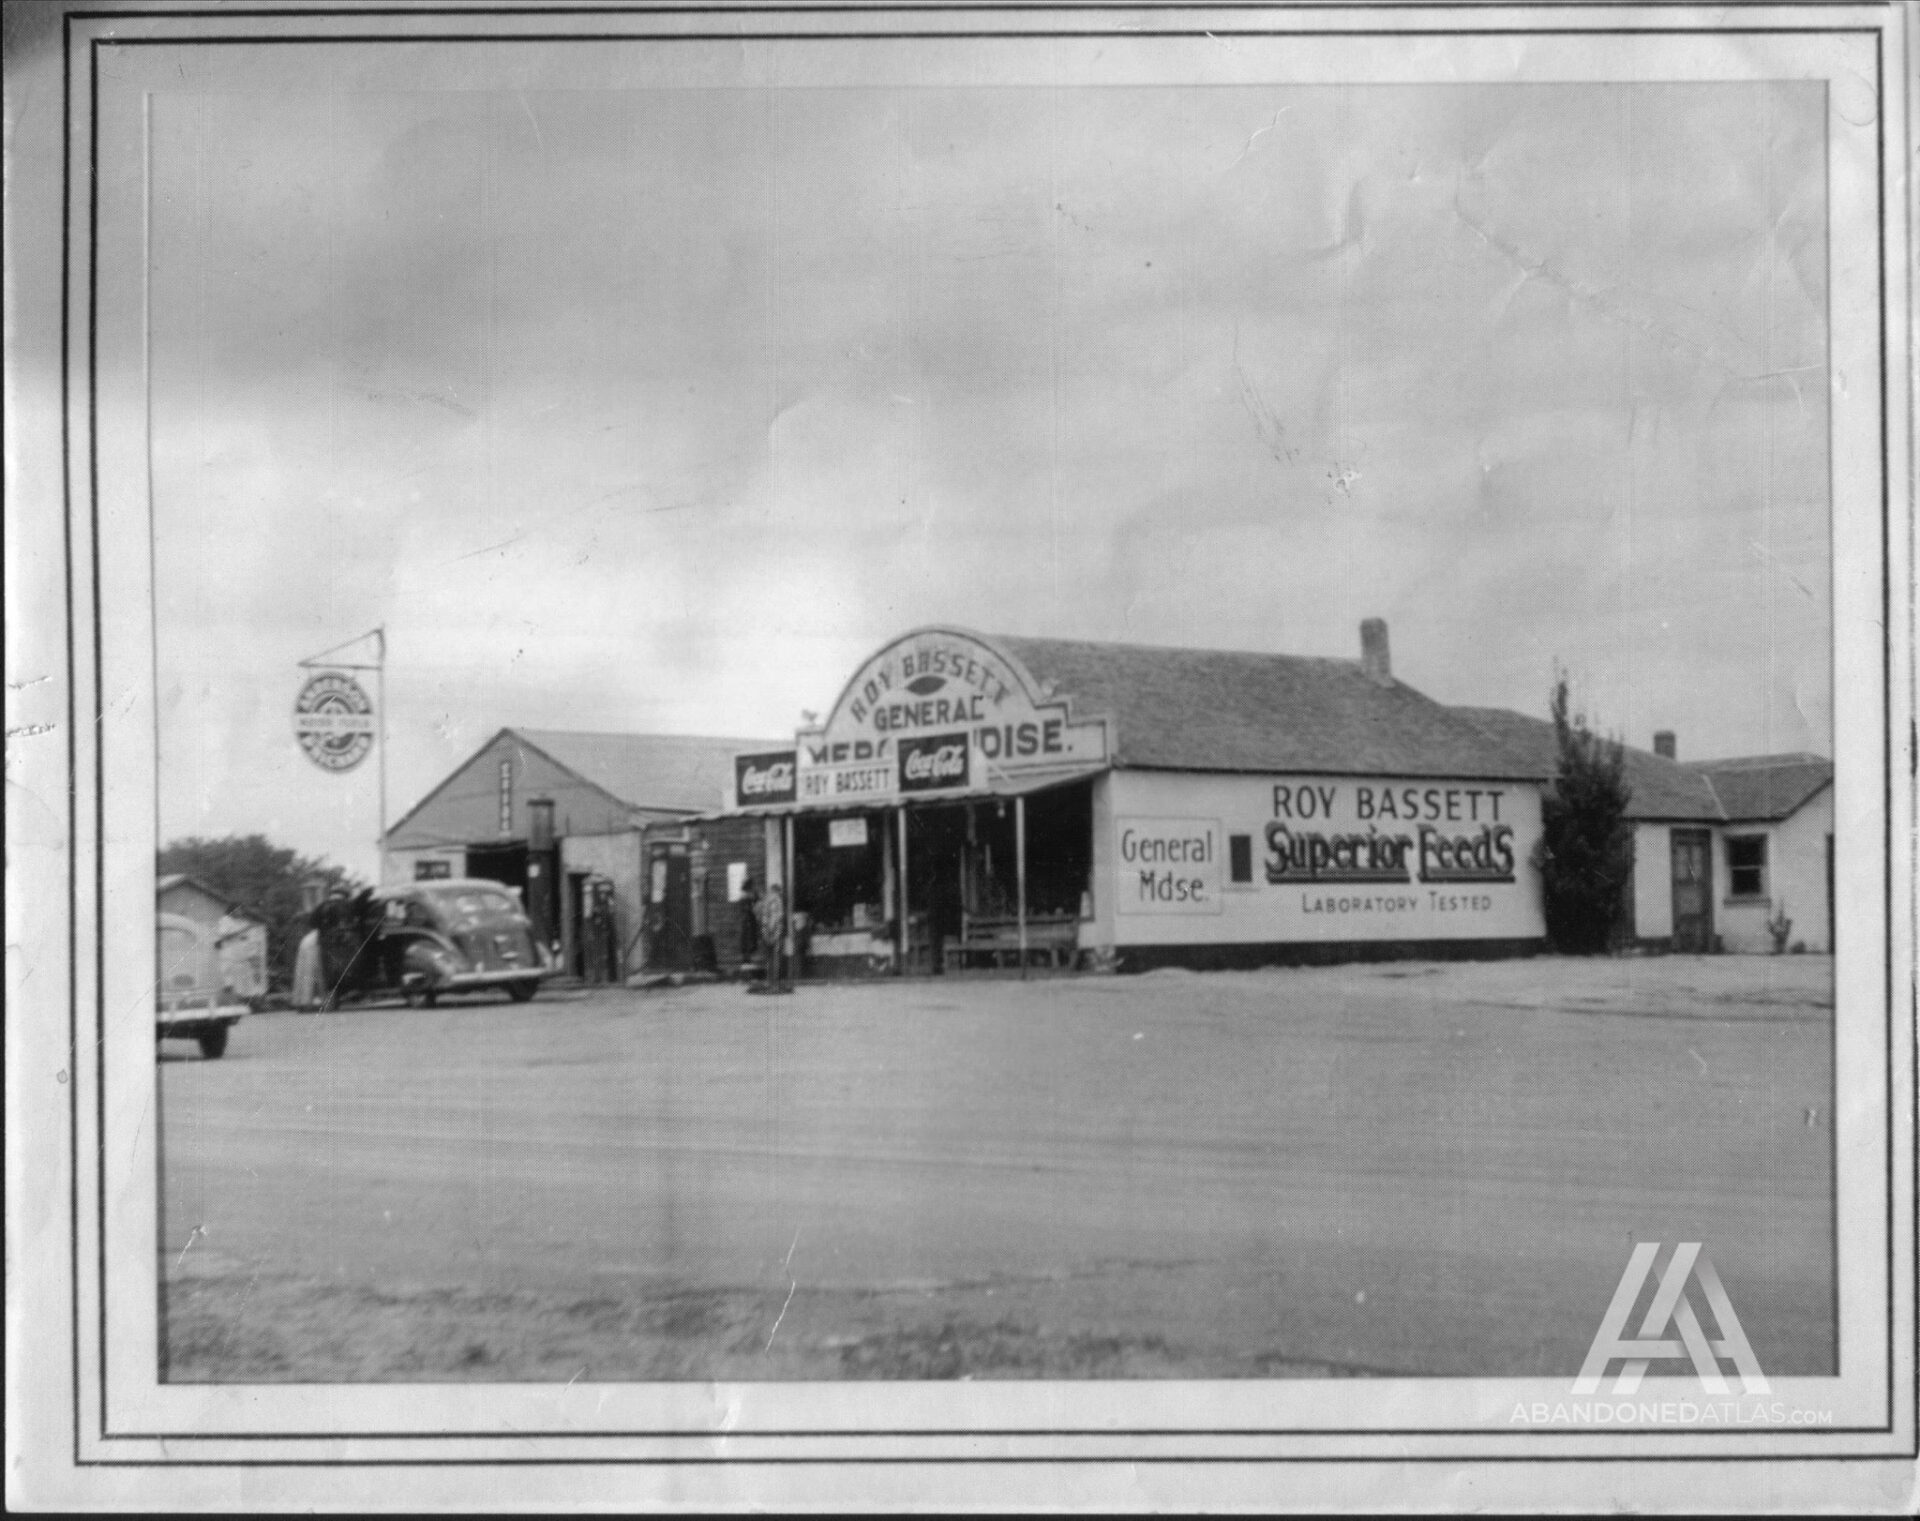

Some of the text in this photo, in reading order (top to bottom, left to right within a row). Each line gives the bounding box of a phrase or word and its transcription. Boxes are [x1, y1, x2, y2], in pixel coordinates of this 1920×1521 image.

[850, 651, 1010, 723] ROY BASSETT
[874, 695, 985, 731] GENERAL
[805, 767, 891, 796] ROY BASSETT
[1273, 784, 1505, 822] ROY BASSETT
[1121, 829, 1213, 863] General
[1264, 820, 1516, 883] Superior Feeds
[1139, 870, 1210, 902] Mdse.
